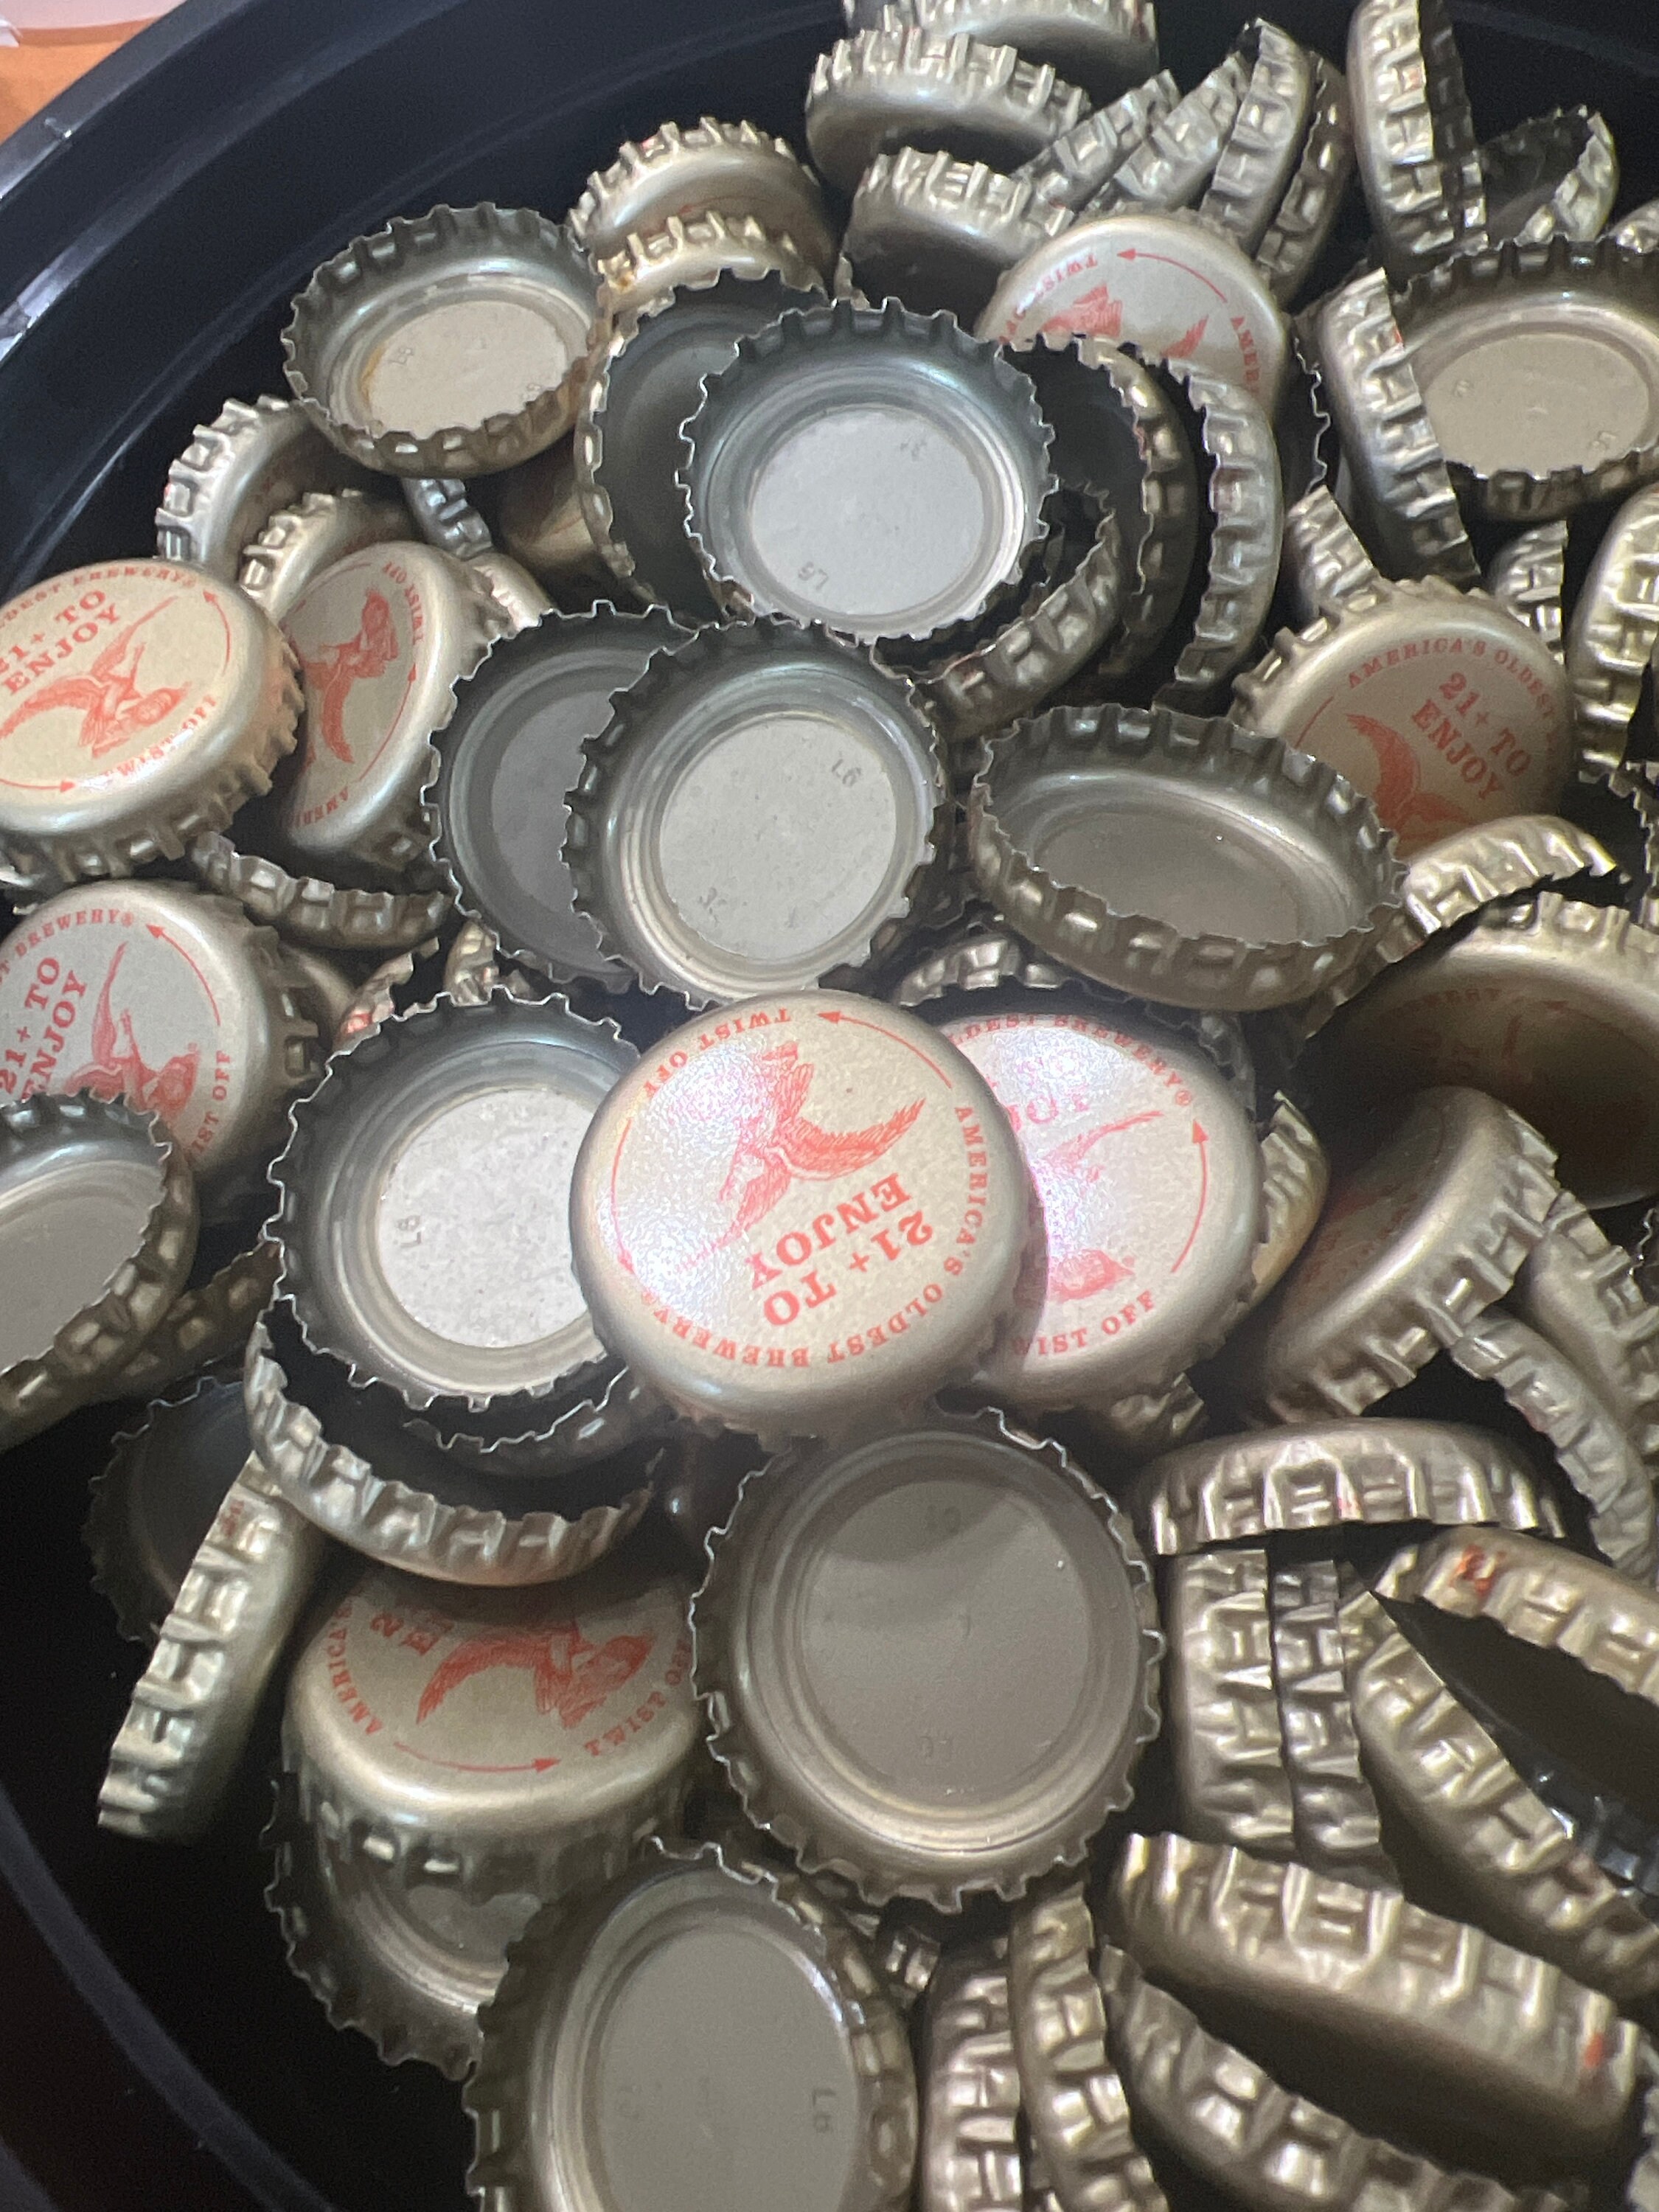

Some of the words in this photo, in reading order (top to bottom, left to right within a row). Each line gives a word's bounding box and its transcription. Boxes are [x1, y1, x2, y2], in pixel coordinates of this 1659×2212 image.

[55, 590, 105, 624] TO
[4, 603, 119, 695] ENJOY
[1348, 637, 1486, 689] AMERICA'S
[1495, 649, 1556, 720] OLDEST
[1411, 698, 1503, 801] ENJOY
[1439, 672, 1489, 724] 21+
[1489, 727, 1532, 778] TO
[24, 957, 60, 1010] TO
[700, 1008, 791, 1051] TWIST
[212, 1050, 232, 1102] OFF
[643, 1050, 689, 1099] OFF
[942, 1105, 988, 1276] AMERICA'S
[746, 1172, 914, 1290] ENJOY
[849, 1210, 934, 1274] 21+
[763, 1269, 838, 1326] TO
[826, 1284, 944, 1364] OLDEST
[1102, 1290, 1155, 1335] OFF
[585, 1691, 666, 1756] TWIST
